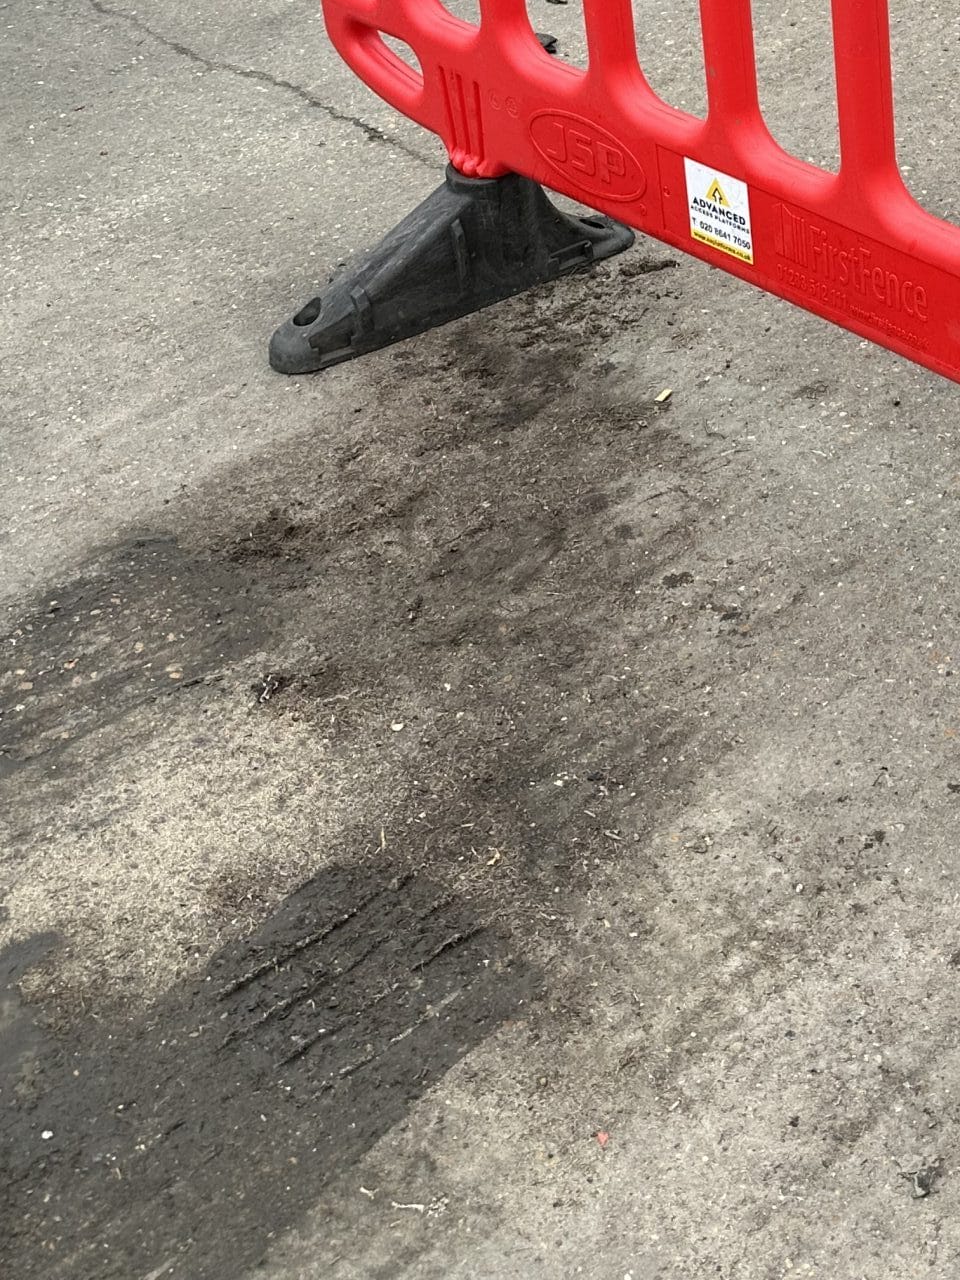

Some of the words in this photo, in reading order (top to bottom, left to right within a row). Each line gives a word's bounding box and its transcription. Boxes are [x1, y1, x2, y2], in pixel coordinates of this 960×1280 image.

[547, 122, 626, 184] JSP
[691, 205, 713, 219] ACCESS
[714, 215, 750, 234] PLATFORMS
[692, 197, 746, 226] ADVANCED
[699, 221, 713, 233] 020
[733, 235, 751, 250] 7050
